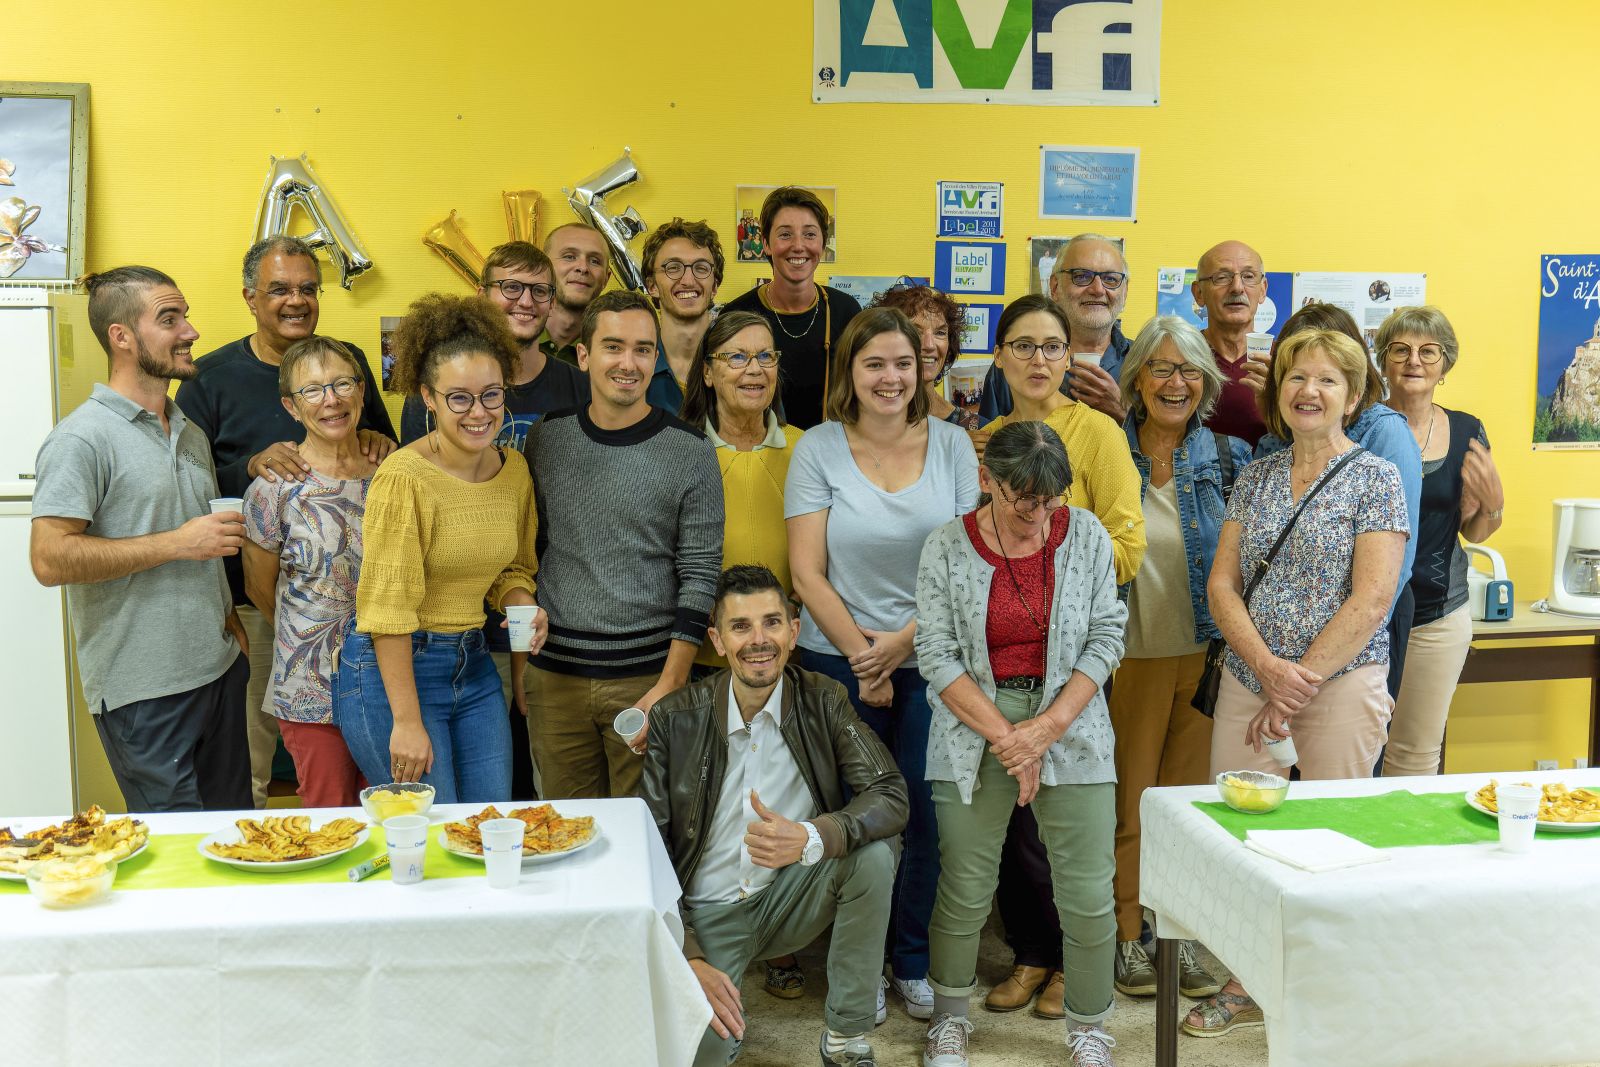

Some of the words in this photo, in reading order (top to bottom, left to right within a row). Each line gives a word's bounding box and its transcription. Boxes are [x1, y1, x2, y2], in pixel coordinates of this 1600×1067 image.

[943, 219, 980, 233] Label
[981, 220, 996, 228] 2011
[955, 251, 988, 266] Label
